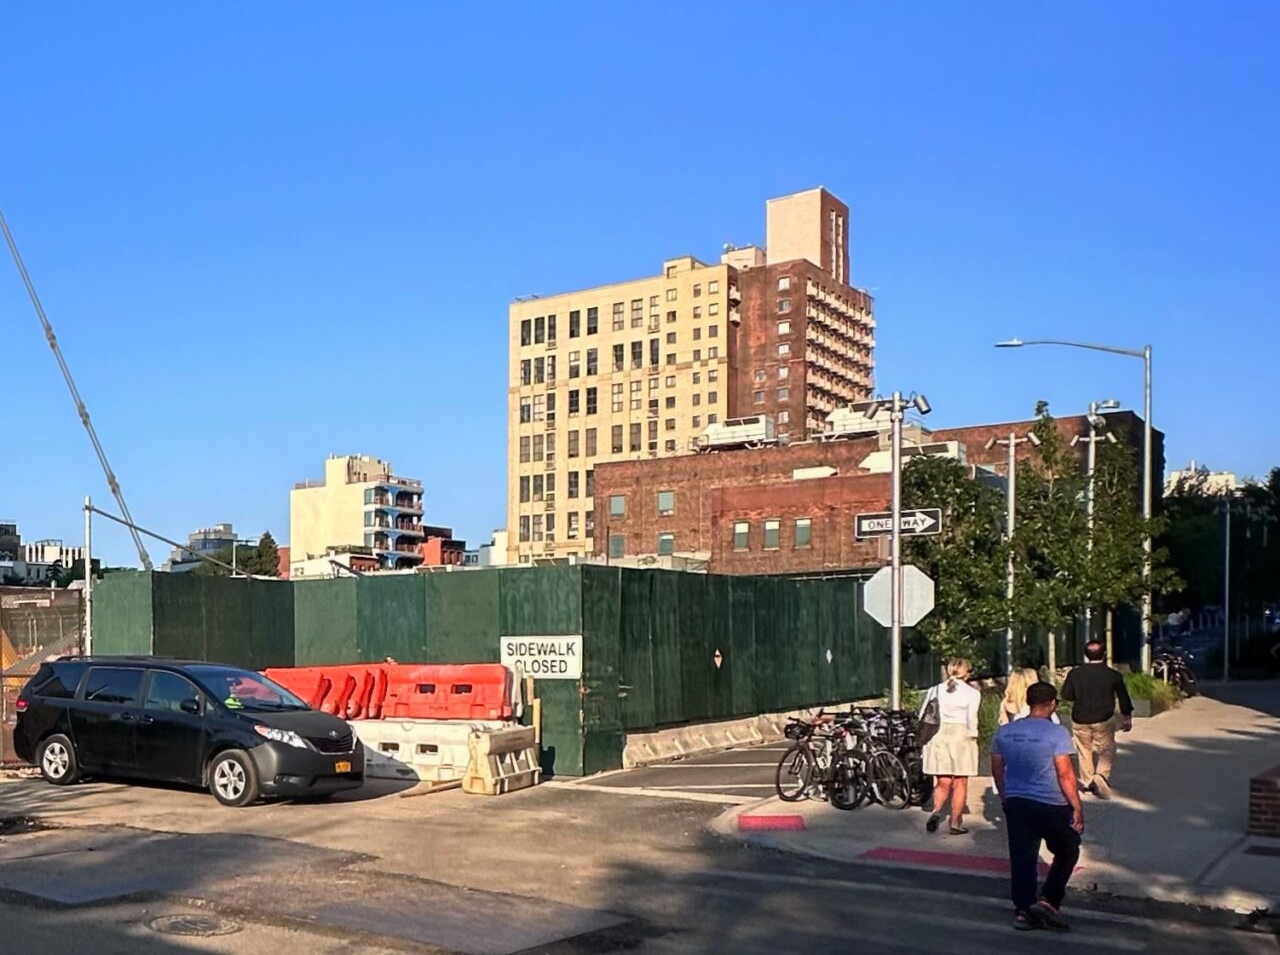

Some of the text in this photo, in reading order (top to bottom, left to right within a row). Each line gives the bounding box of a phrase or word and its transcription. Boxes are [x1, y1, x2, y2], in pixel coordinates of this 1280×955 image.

[868, 517, 927, 530] ONE WAY
[506, 642, 576, 656] SIDEWALK
